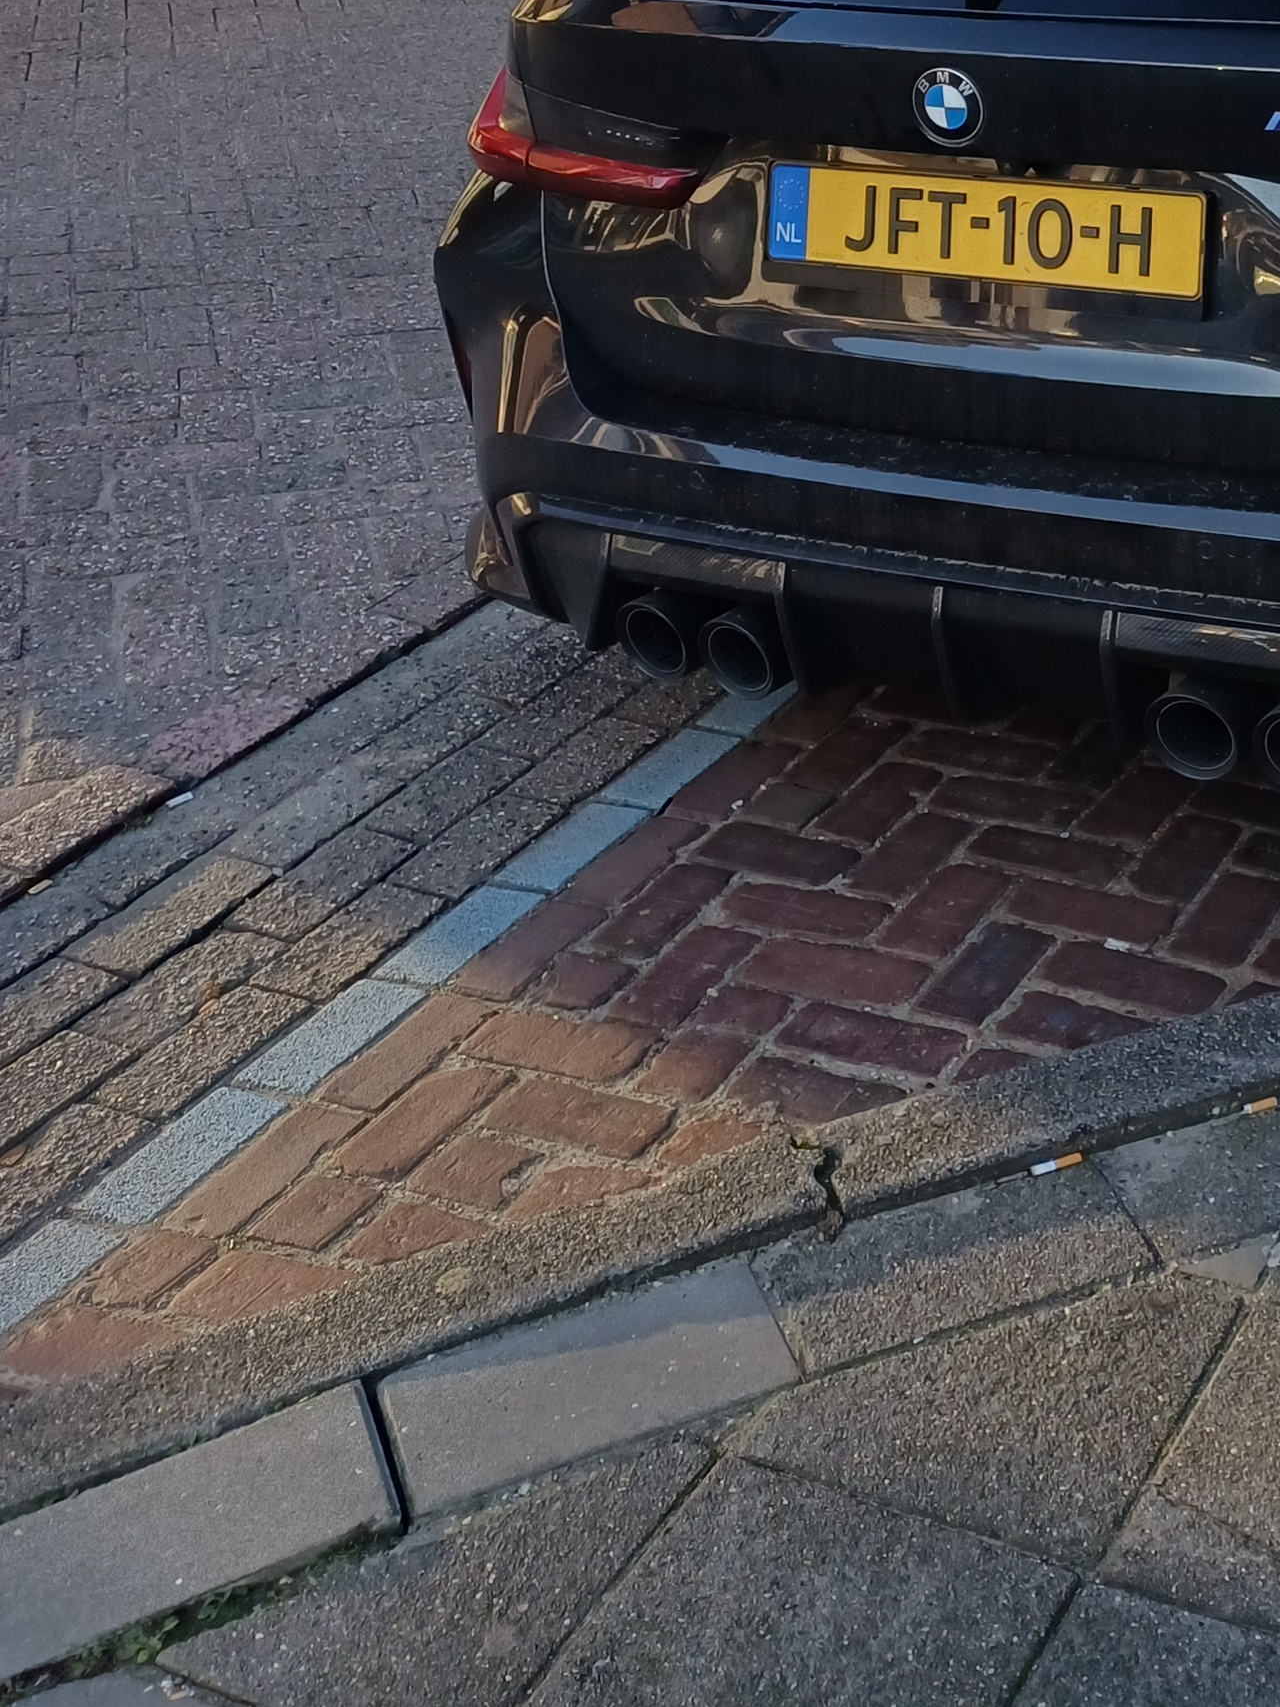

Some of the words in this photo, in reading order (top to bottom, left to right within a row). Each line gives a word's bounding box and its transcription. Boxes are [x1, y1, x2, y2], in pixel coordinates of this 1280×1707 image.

[917, 71, 974, 97] BMW
[775, 221, 802, 244] NL
[844, 184, 1153, 278] JFT-10-H
